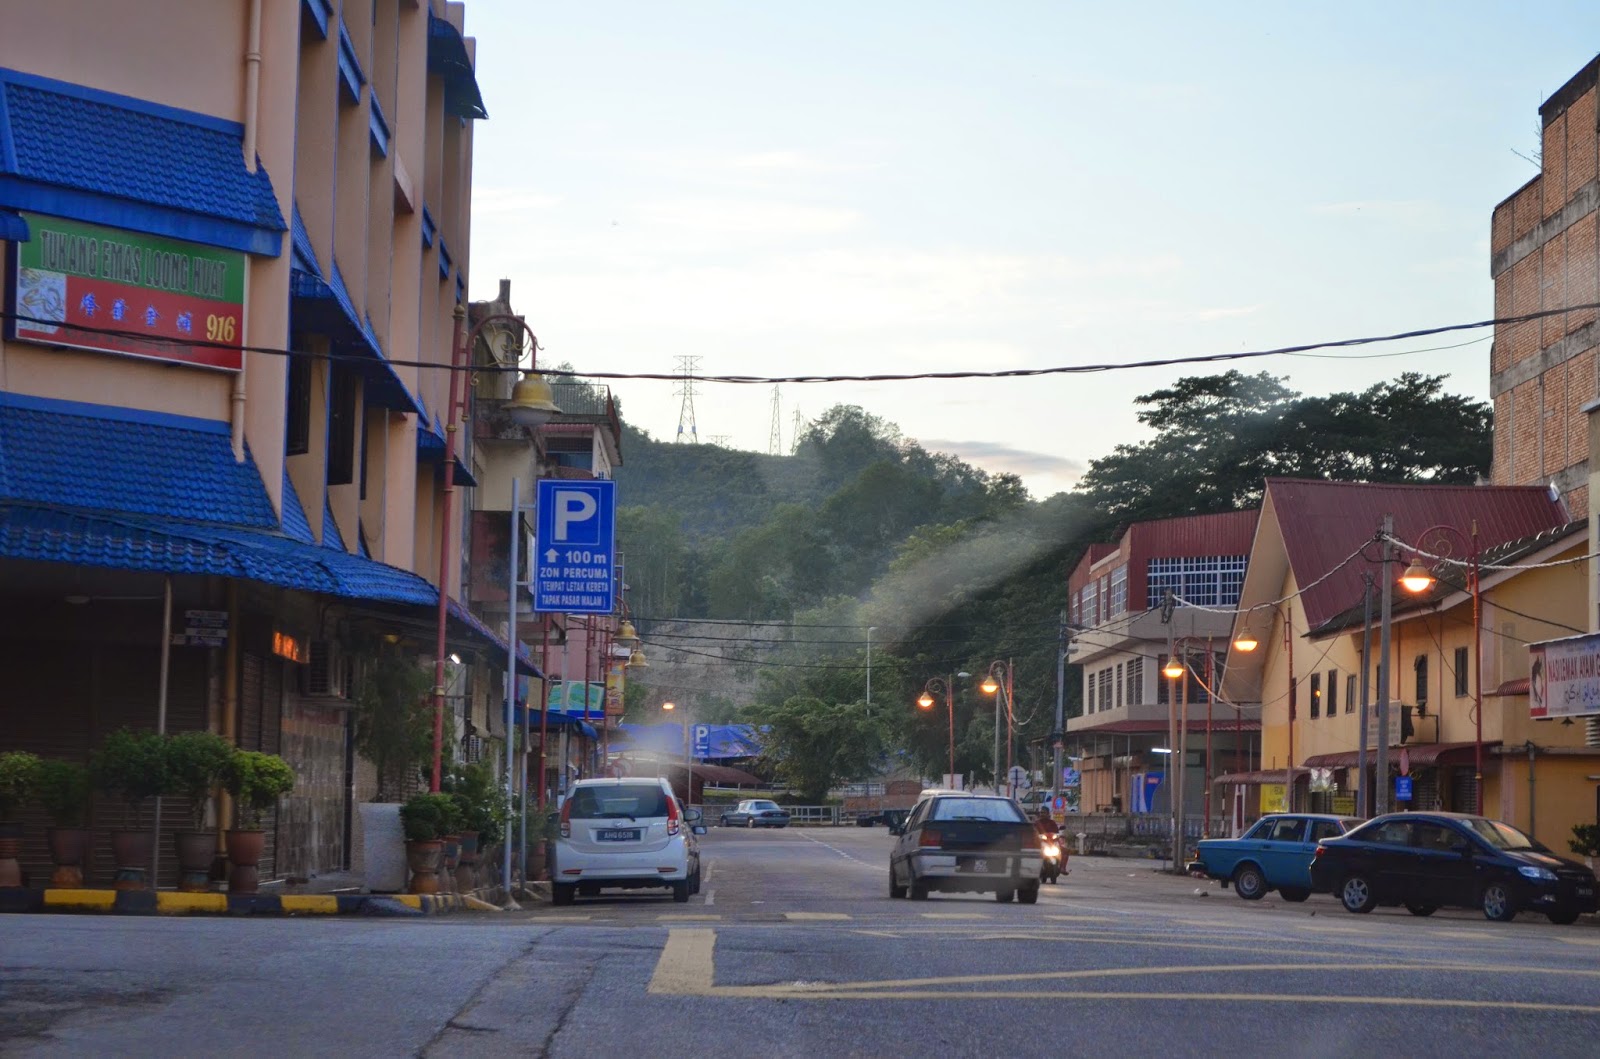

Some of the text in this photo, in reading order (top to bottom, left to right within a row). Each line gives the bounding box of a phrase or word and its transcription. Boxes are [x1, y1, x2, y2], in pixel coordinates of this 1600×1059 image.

[40, 229, 226, 298] TUKANG EMAS LOONG HUAT
[206, 314, 235, 342] 916
[554, 490, 597, 540] P
[565, 551, 606, 564] 100 m
[540, 567, 608, 579] ZON PERCUMA
[566, 582, 585, 592] LETAK
[586, 582, 609, 593] KERETA
[542, 595, 560, 606] TAPAK
[561, 595, 581, 606] PASAR
[1561, 656, 1578, 682] LEMAK
[1580, 654, 1596, 679] AYAM
[696, 726, 708, 744] P
